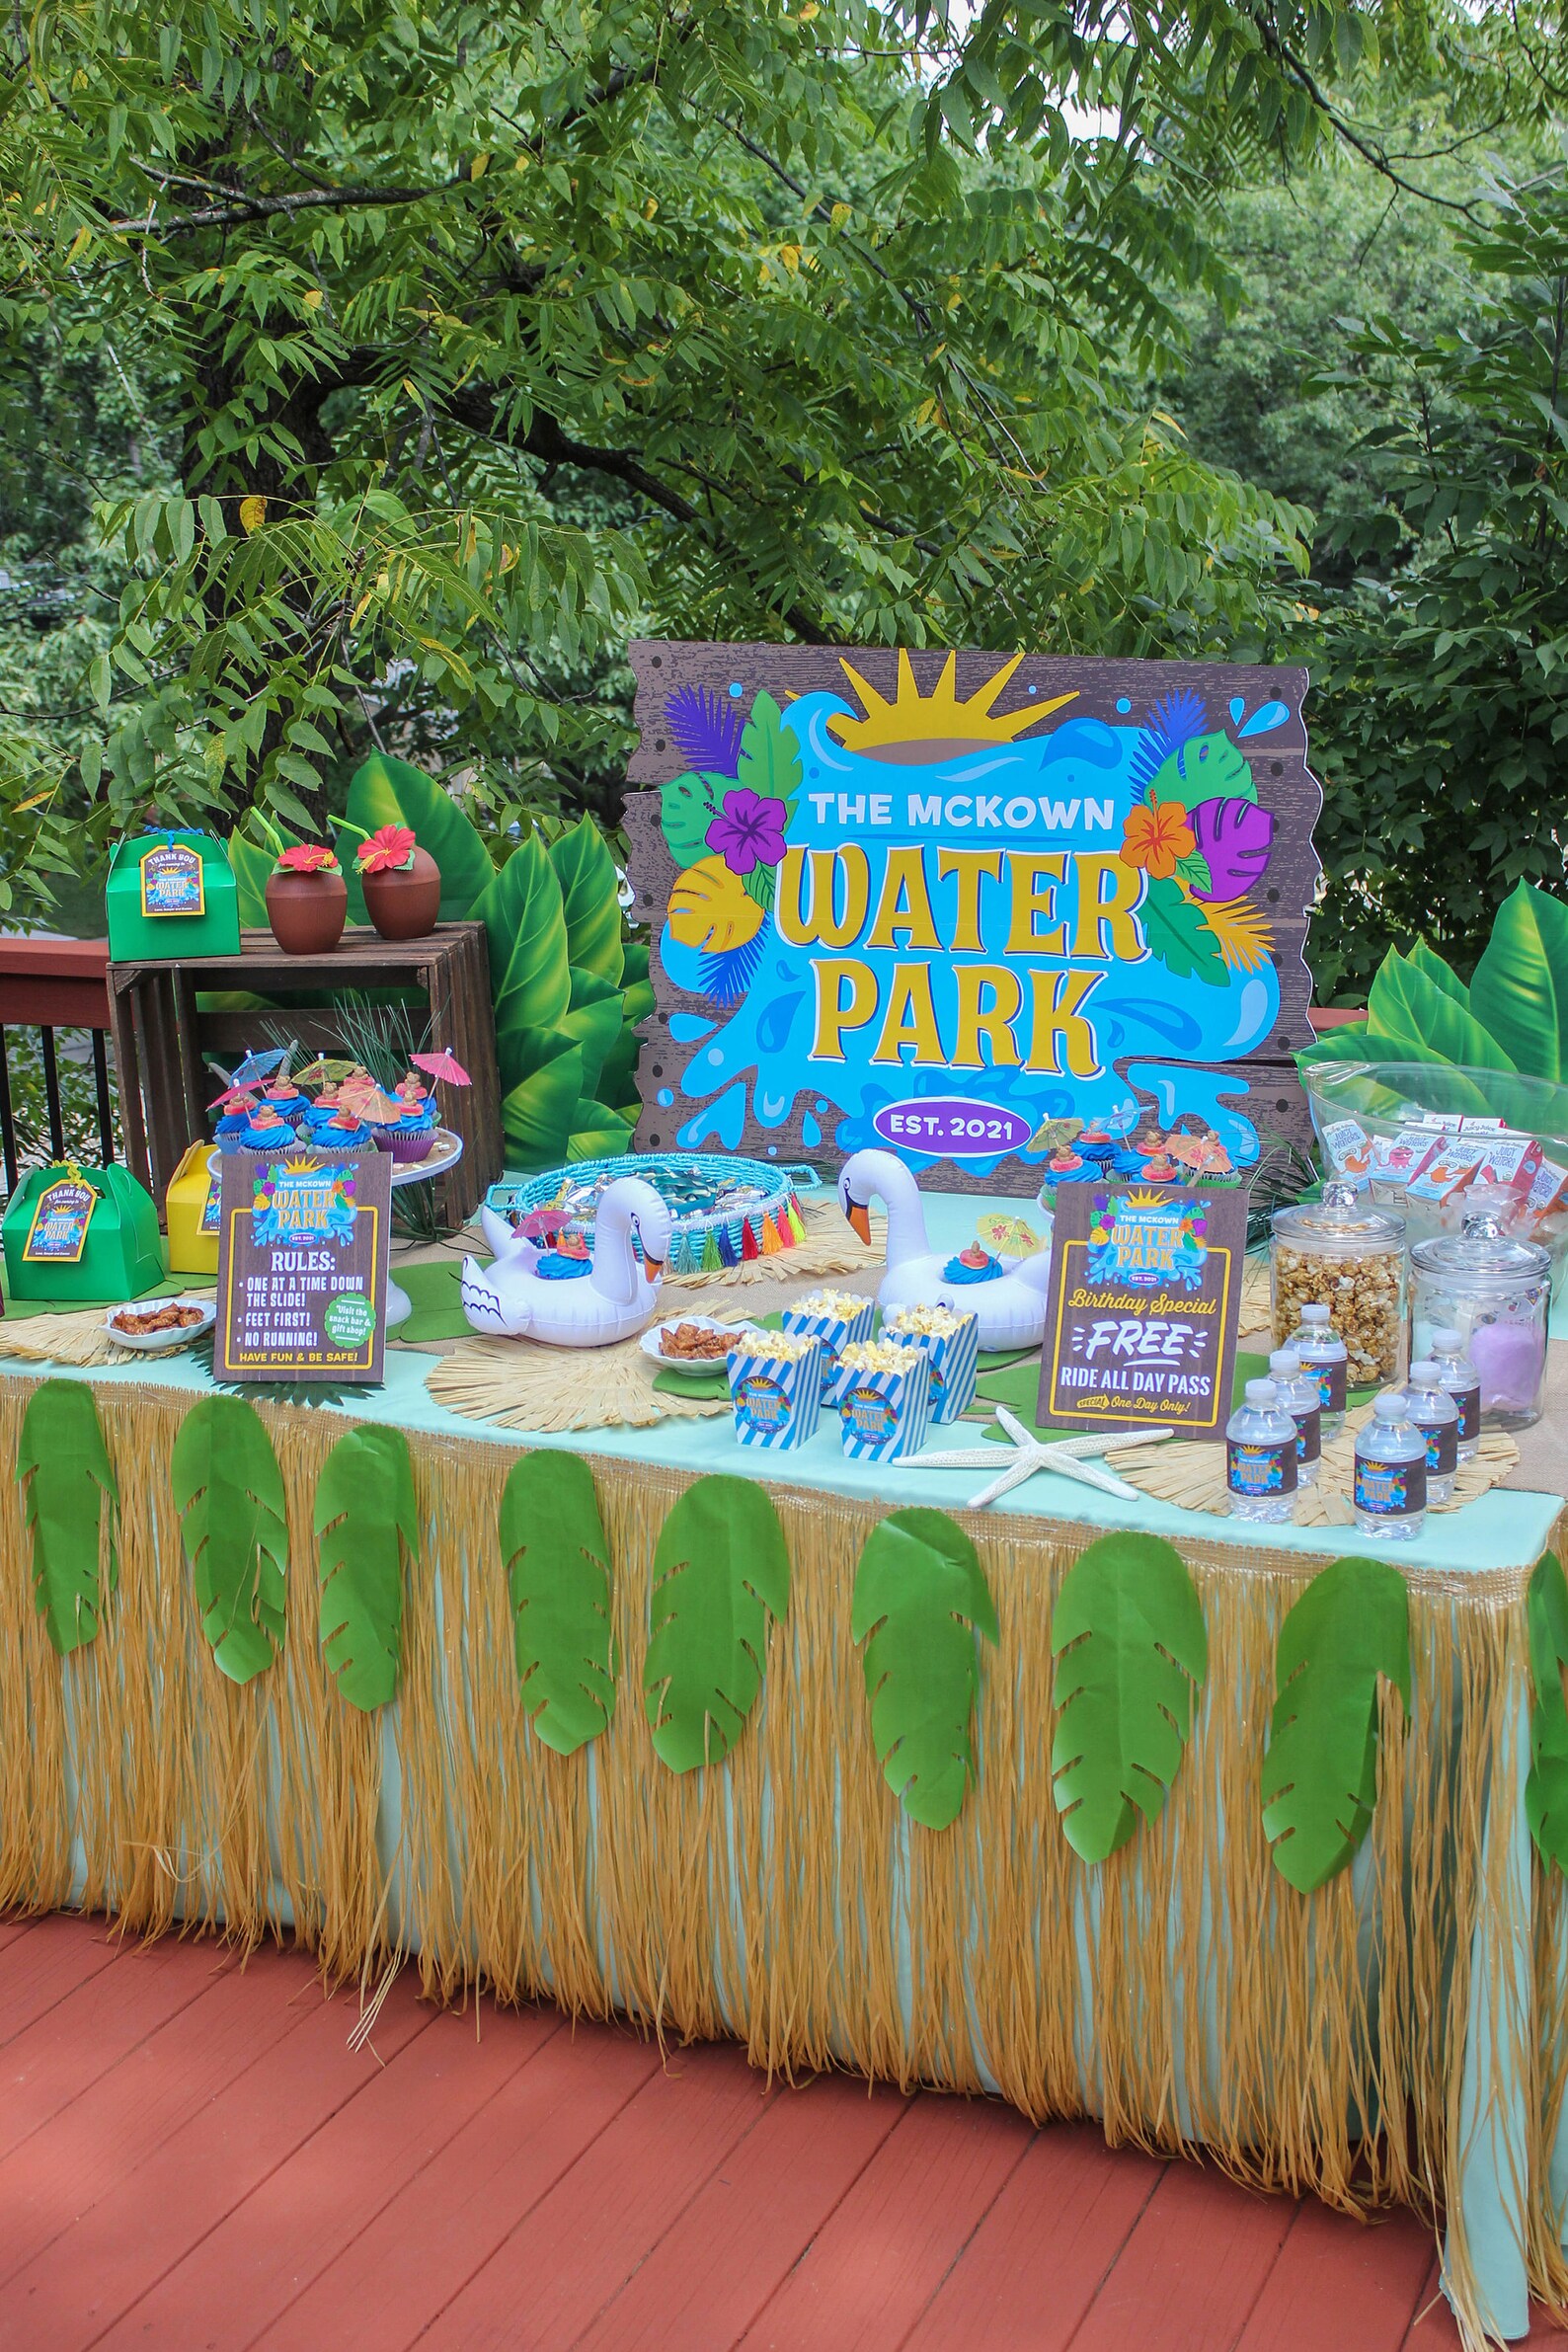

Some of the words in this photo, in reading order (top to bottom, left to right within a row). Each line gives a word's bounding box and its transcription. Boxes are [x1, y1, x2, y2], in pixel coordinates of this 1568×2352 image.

[808, 792, 892, 827] THE
[907, 794, 1115, 830] MCKOWN
[148, 853, 177, 865] THANK
[178, 853, 196, 864] YOU
[774, 842, 1151, 964] WATER
[807, 958, 1109, 1079] PARK
[890, 1114, 943, 1137] EST.
[950, 1117, 1014, 1140] 2021
[46, 1189, 75, 1202] THANK
[74, 1189, 91, 1202] YOU
[272, 1189, 337, 1210] WATER
[276, 1209, 329, 1229] PARK
[1138, 1215, 1179, 1224] MCKOWN
[1111, 1224, 1185, 1248] WATER
[271, 1251, 336, 1272] RULES:
[1116, 1246, 1176, 1271] PARK
[247, 1277, 268, 1292] ONE
[271, 1277, 285, 1292] AT
[288, 1277, 296, 1291] A
[300, 1277, 327, 1291] TIME
[331, 1276, 363, 1291] DOWN
[247, 1293, 267, 1307] THE
[271, 1293, 306, 1307] SLIDE!
[1067, 1288, 1147, 1315] Birthday
[1148, 1293, 1217, 1315] Special
[245, 1312, 271, 1327] FEET
[274, 1312, 310, 1327] FIRST!
[329, 1314, 350, 1324] snack
[351, 1317, 363, 1326] bar
[336, 1304, 354, 1316] Visit
[355, 1307, 367, 1317] the
[244, 1332, 260, 1347] NO
[263, 1332, 318, 1347] RUNNING!
[332, 1324, 346, 1334] gift
[346, 1325, 366, 1337] shop!
[1085, 1320, 1194, 1361] FREE
[239, 1353, 267, 1362] HAVE
[271, 1353, 293, 1362] FUN
[296, 1353, 305, 1362] &
[309, 1353, 323, 1362] BE
[326, 1352, 358, 1362] SAFE!
[1060, 1367, 1099, 1388] RIDE
[1100, 1370, 1130, 1390] ALL
[1133, 1372, 1166, 1393] DAY
[1167, 1374, 1212, 1396] PASS
[1078, 1397, 1106, 1408] SPECIAL
[1111, 1395, 1132, 1408] One
[1134, 1397, 1158, 1413] Day
[1159, 1399, 1192, 1415] Only!
